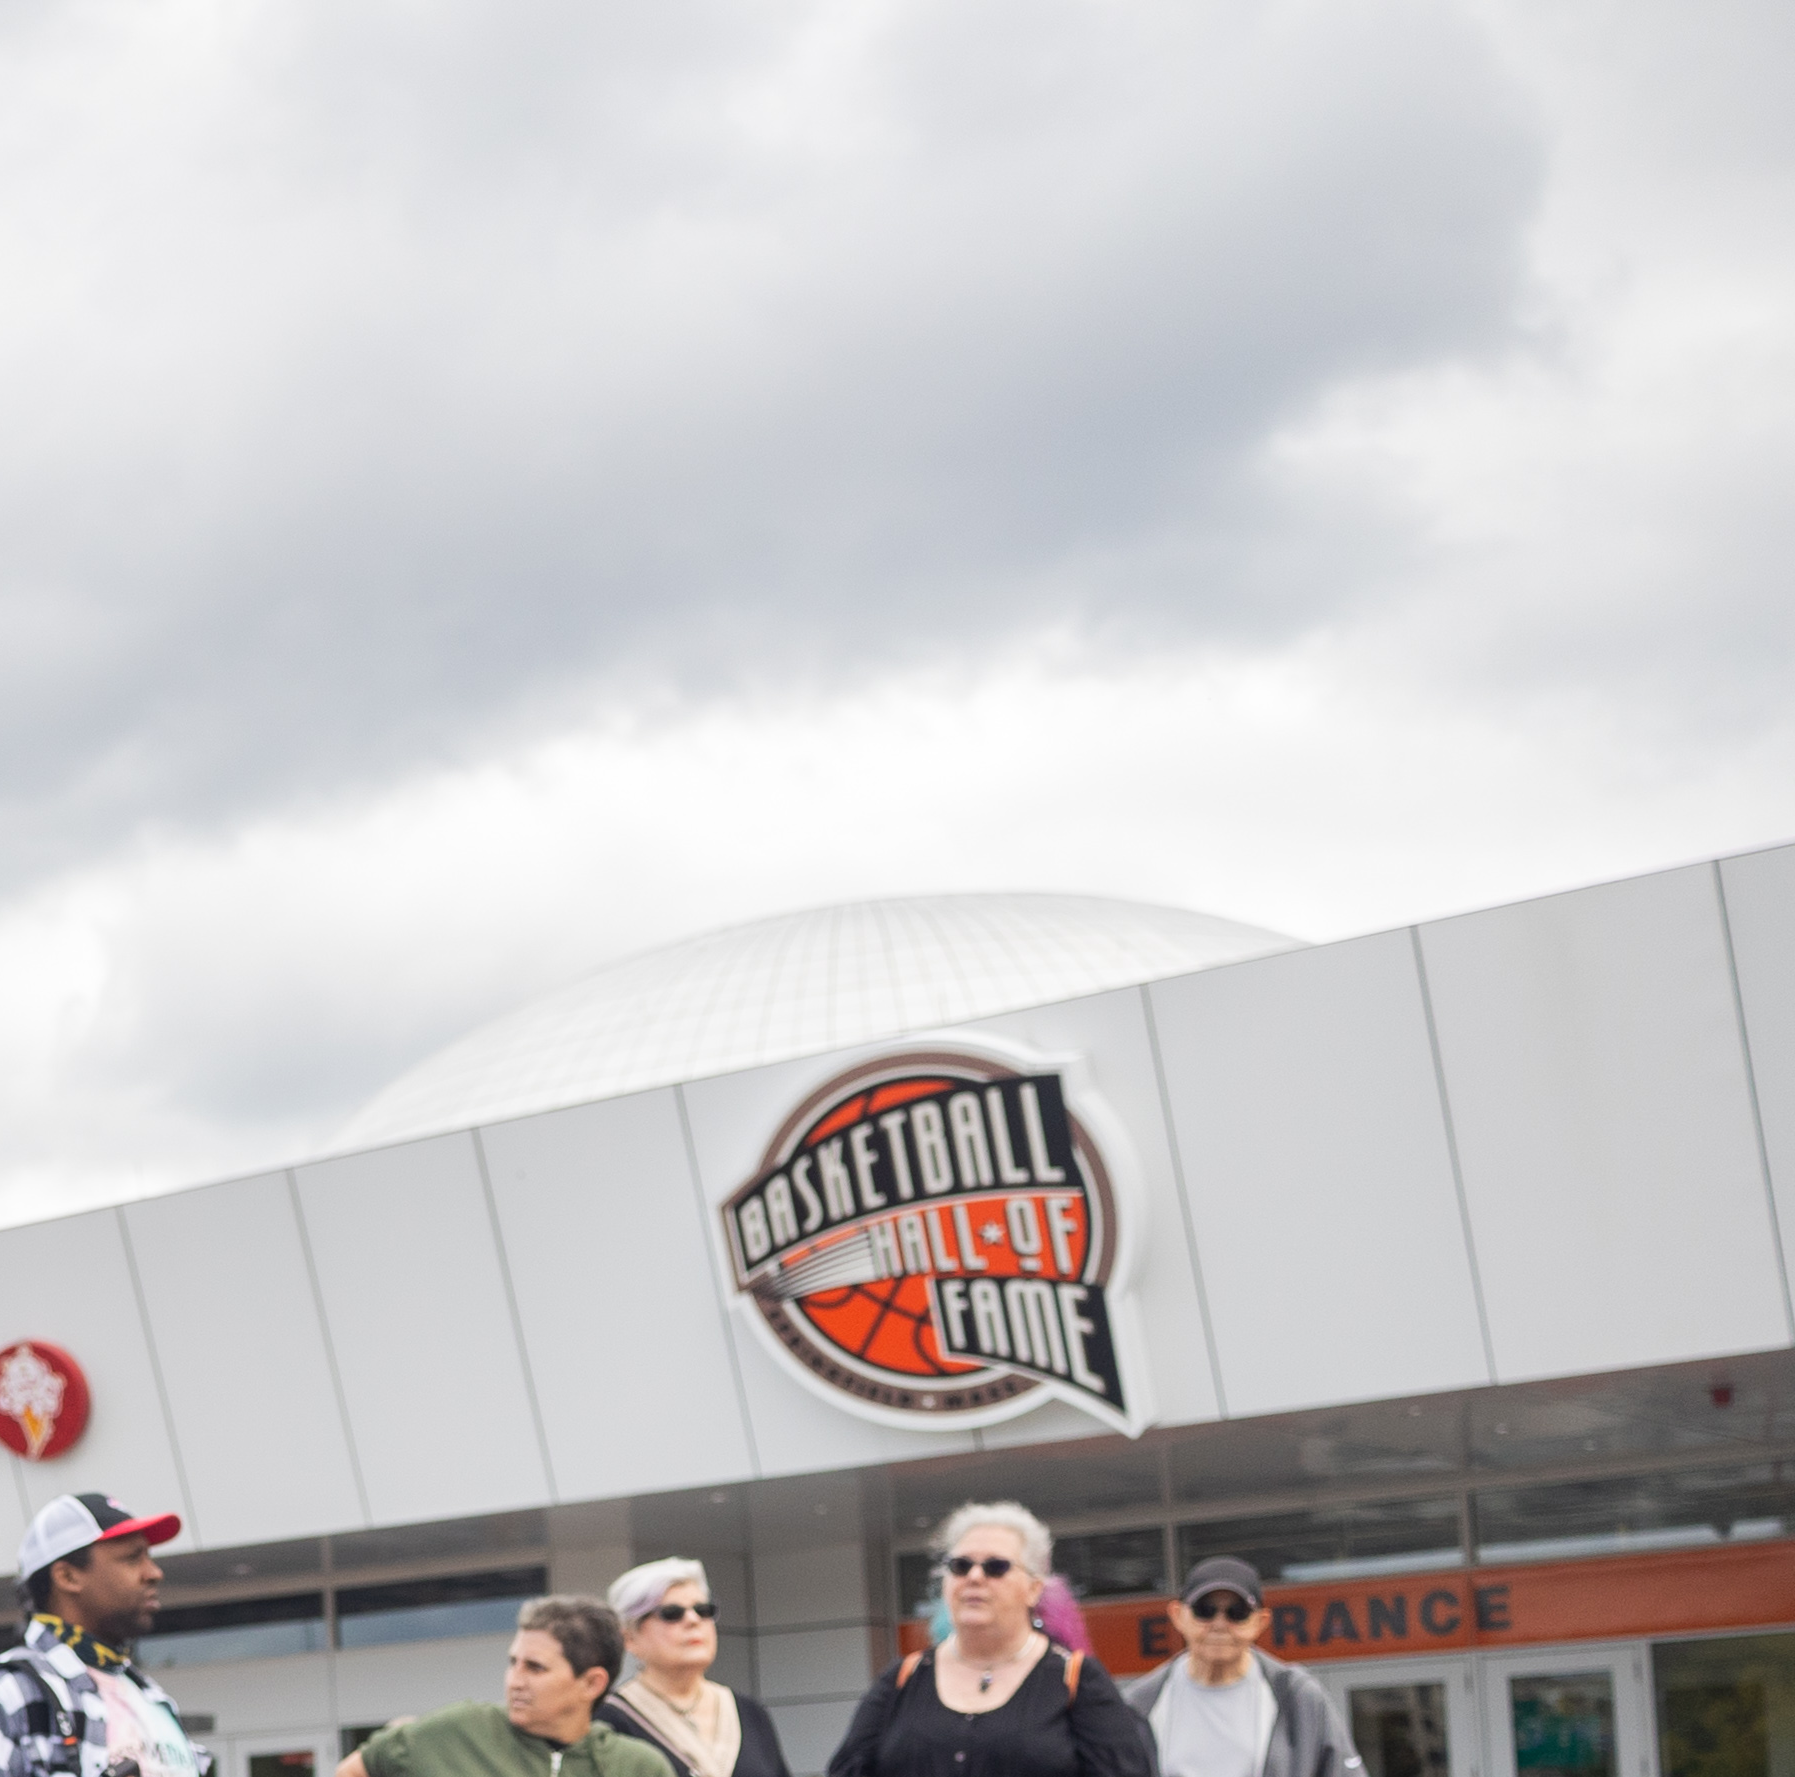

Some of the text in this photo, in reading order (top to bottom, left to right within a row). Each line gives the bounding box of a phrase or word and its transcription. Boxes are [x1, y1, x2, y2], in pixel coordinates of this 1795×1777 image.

[738, 1082, 1065, 1261] BASKETBALL
[869, 1197, 1078, 1280] HALL OF
[941, 1278, 1106, 1396] FAME
[1137, 1585, 1512, 1659] ERANCE
